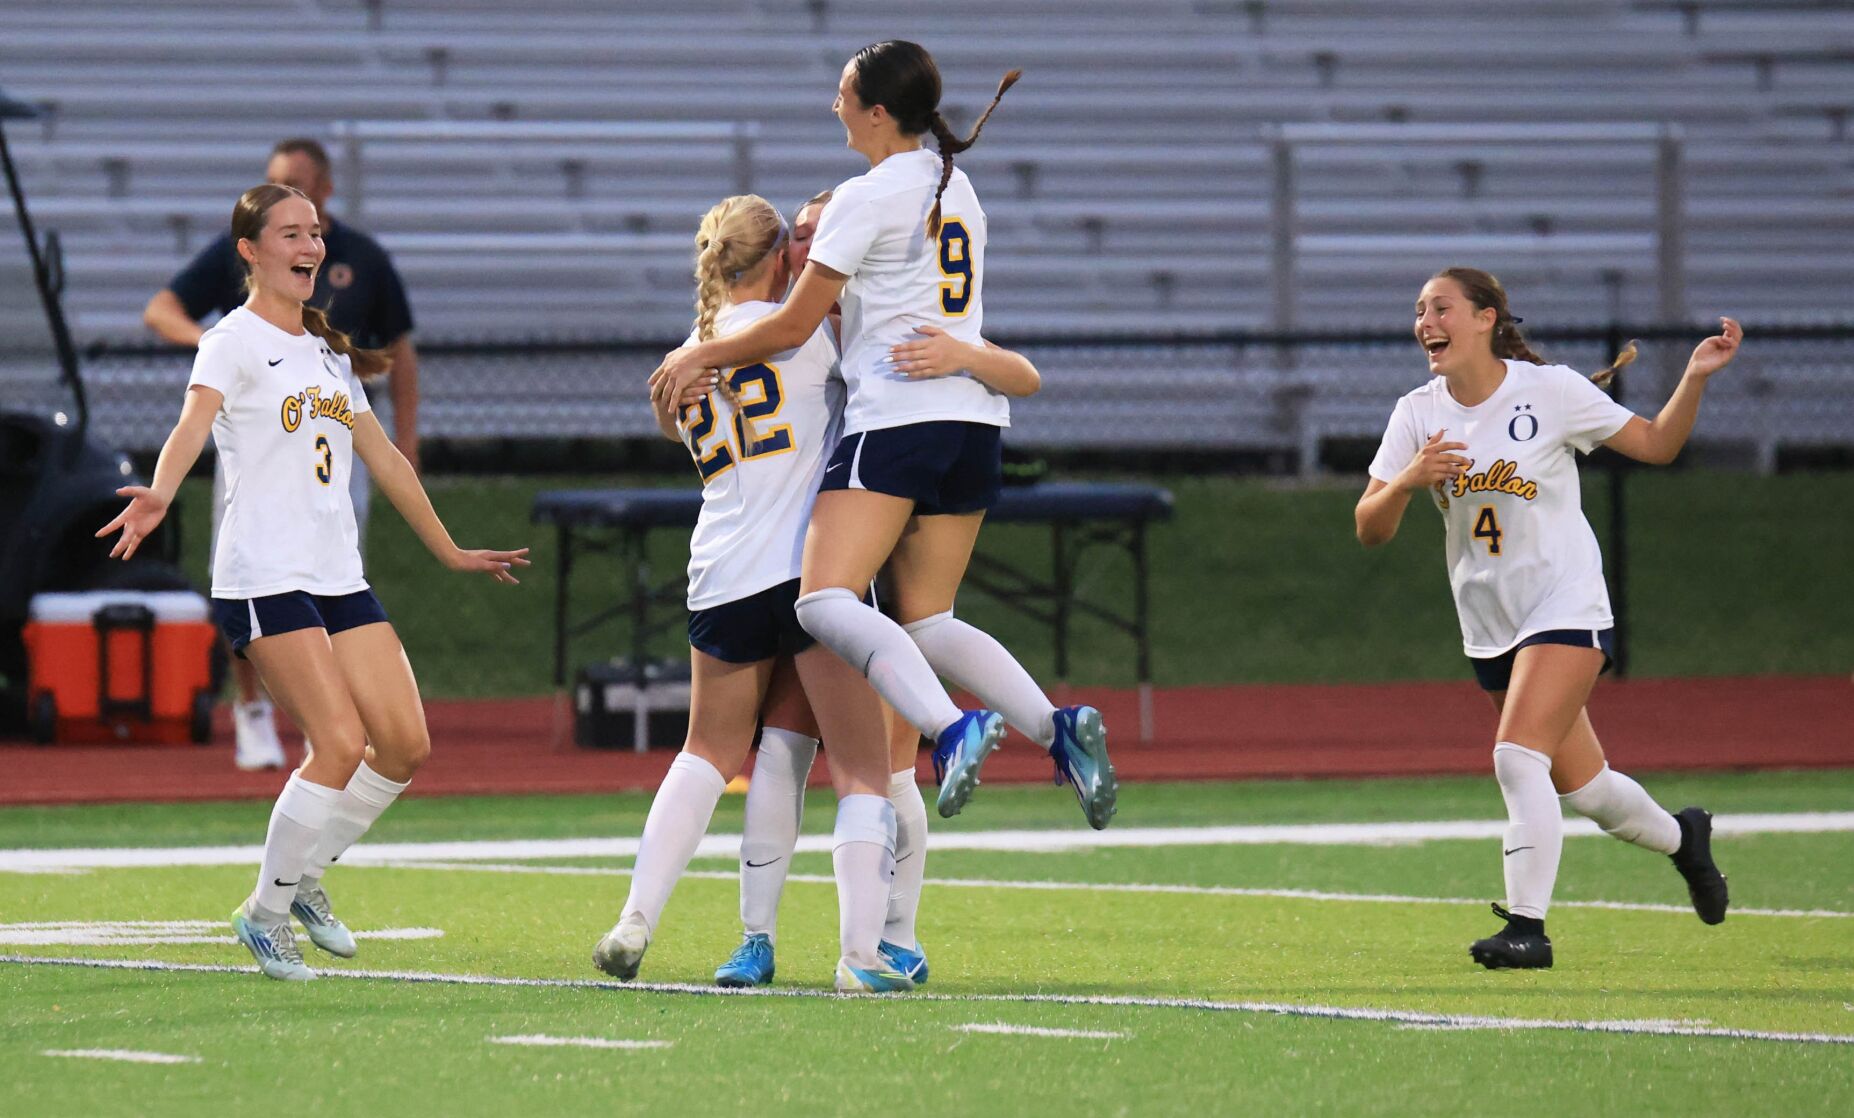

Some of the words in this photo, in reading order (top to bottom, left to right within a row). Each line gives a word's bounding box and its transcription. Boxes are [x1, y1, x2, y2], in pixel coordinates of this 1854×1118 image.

[936, 215, 975, 318] 9
[676, 359, 798, 485] 22
[1508, 414, 1539, 442] O
[315, 433, 333, 487] 3
[1471, 503, 1503, 557] 4
